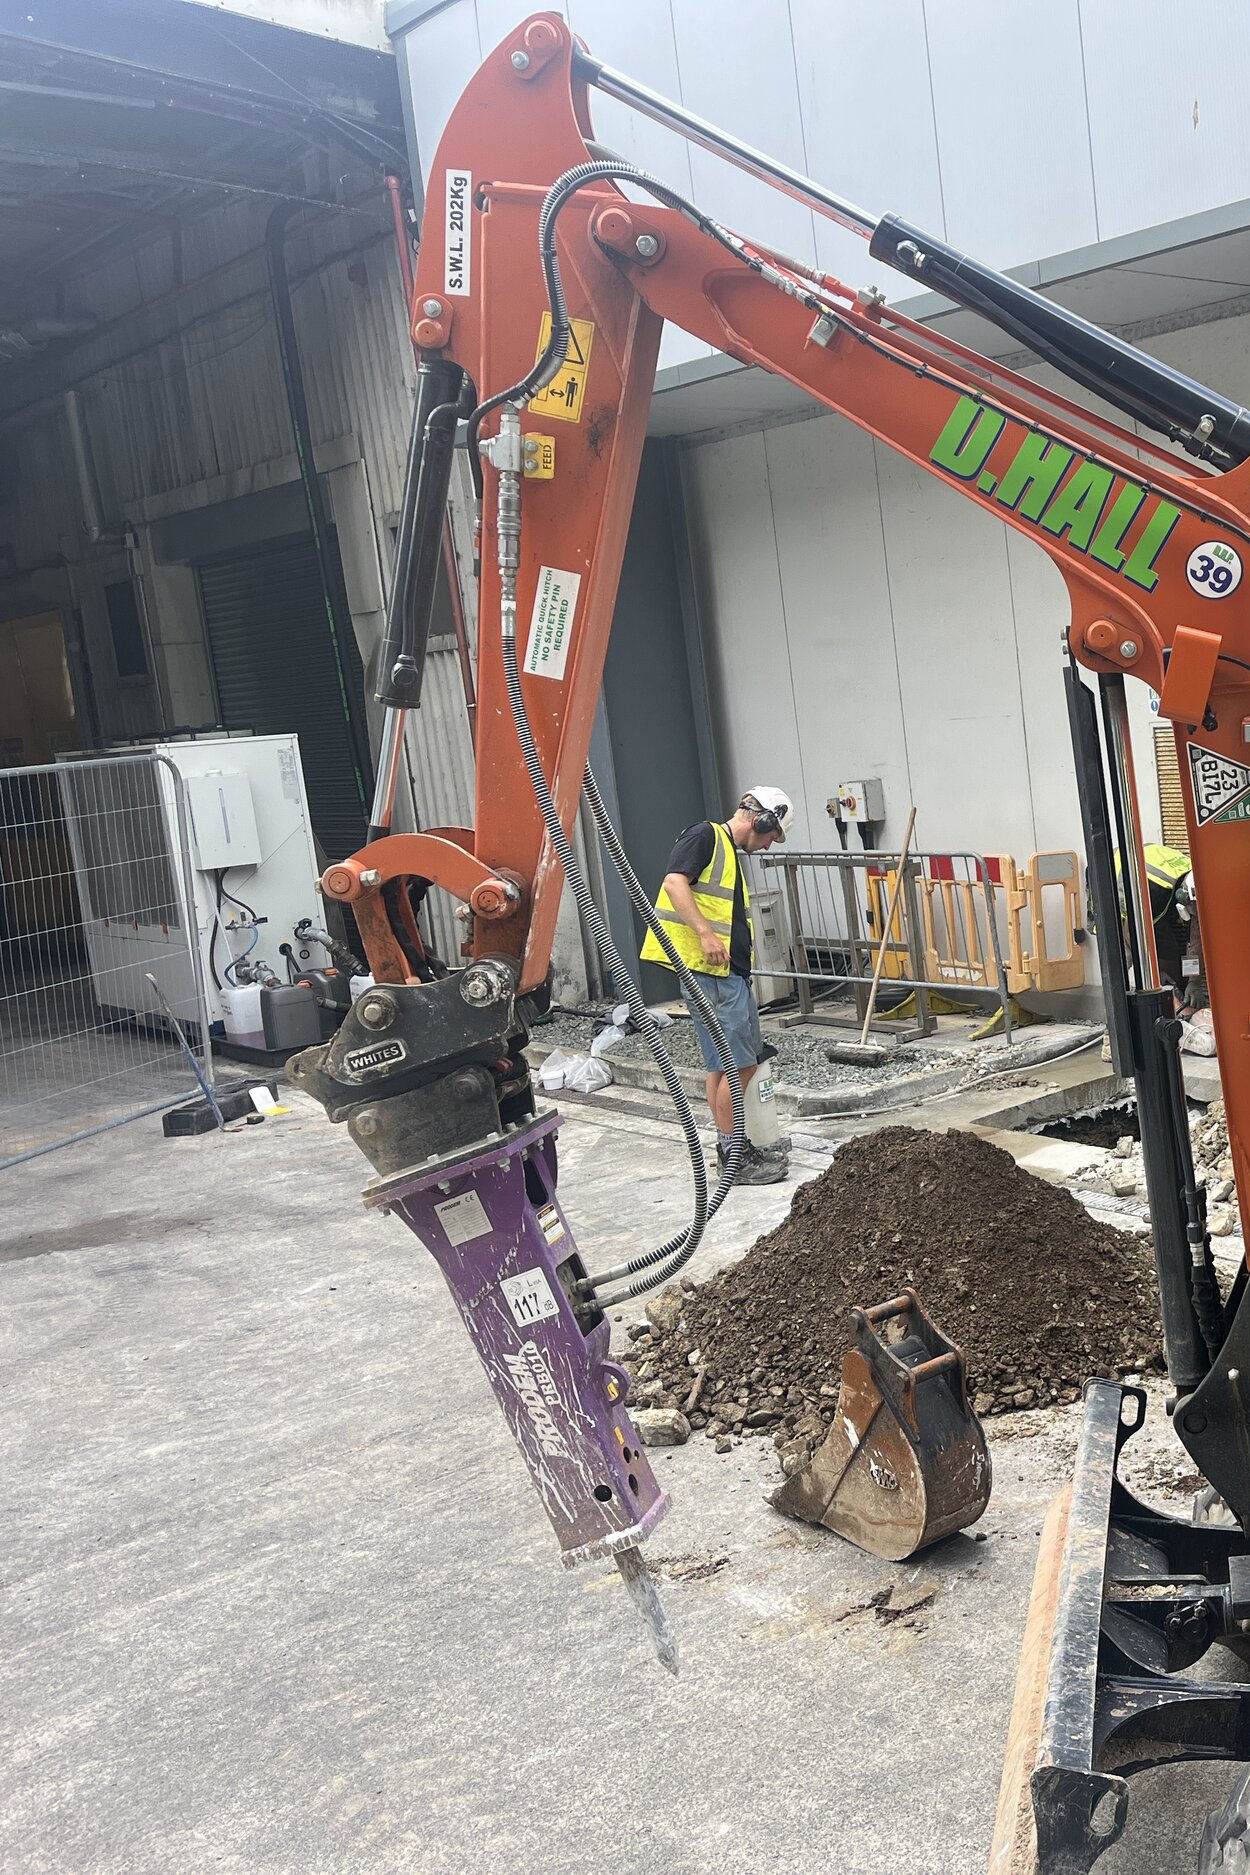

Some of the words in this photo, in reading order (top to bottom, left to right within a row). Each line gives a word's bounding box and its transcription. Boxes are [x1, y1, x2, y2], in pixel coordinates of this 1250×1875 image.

[449, 176, 468, 232] 202Kg
[448, 237, 463, 289] S.W.L.
[542, 444, 553, 470] FEED
[929, 392, 1181, 594] D.HALL
[551, 584, 561, 602] PIN
[1190, 554, 1233, 593] 39
[530, 623, 543, 672] AUTOMATIC
[538, 597, 548, 622] QUICK
[544, 569, 553, 595] HITCH
[545, 604, 557, 644] SAFETY
[553, 599, 569, 651] REQUIRED
[541, 646, 550, 661] NO
[1220, 769, 1239, 790] 23
[350, 1046, 400, 1069] WHITES
[514, 1292, 541, 1320] 117
[544, 1299, 555, 1311] dB
[503, 1353, 570, 1459] PRODEM
